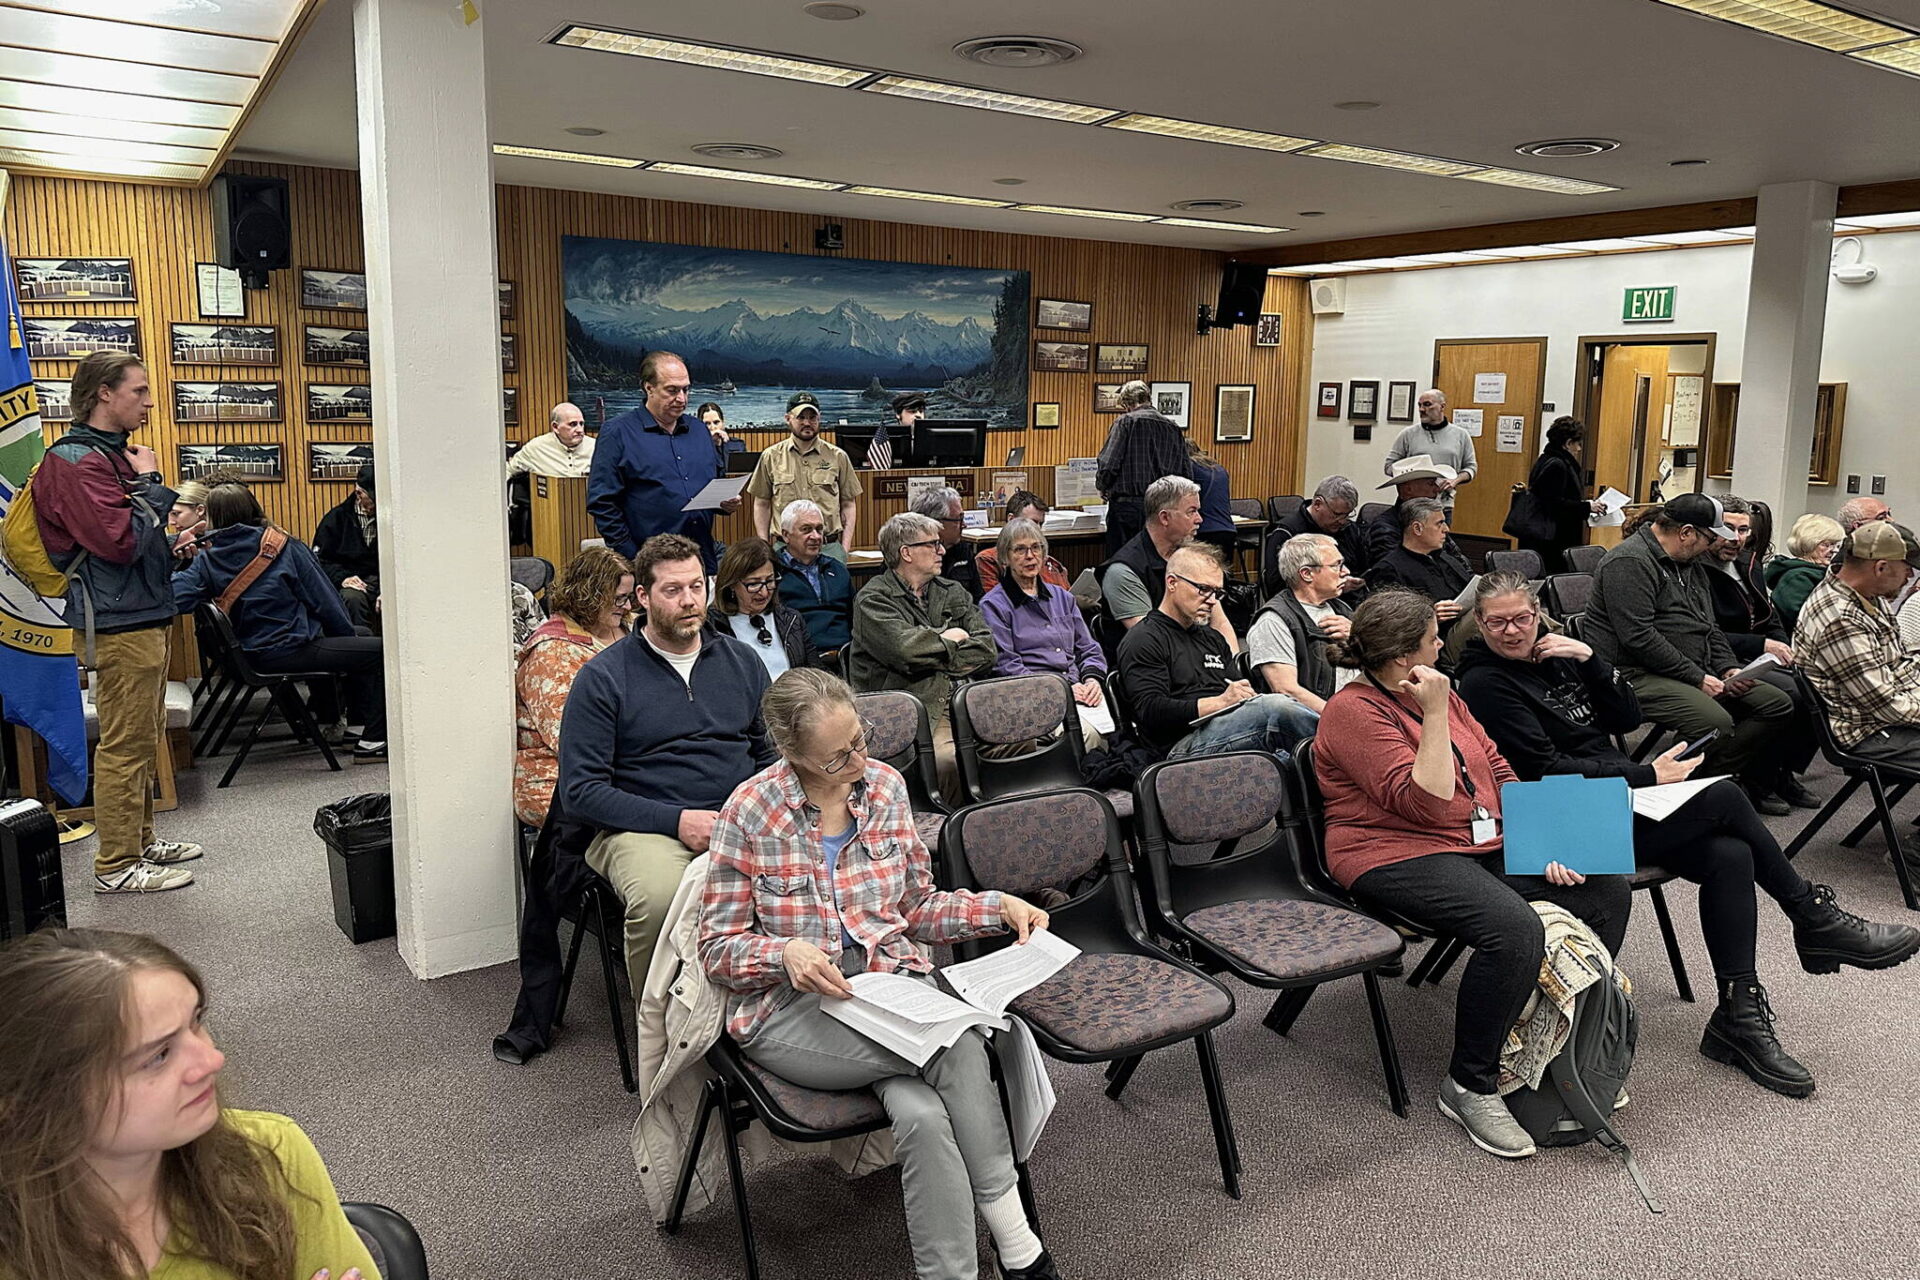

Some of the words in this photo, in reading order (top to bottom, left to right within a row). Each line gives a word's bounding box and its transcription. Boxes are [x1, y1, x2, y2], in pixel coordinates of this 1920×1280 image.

[1631, 289, 1669, 318] EXIT
[886, 482, 908, 492] NE
[10, 629, 53, 648] 1970
